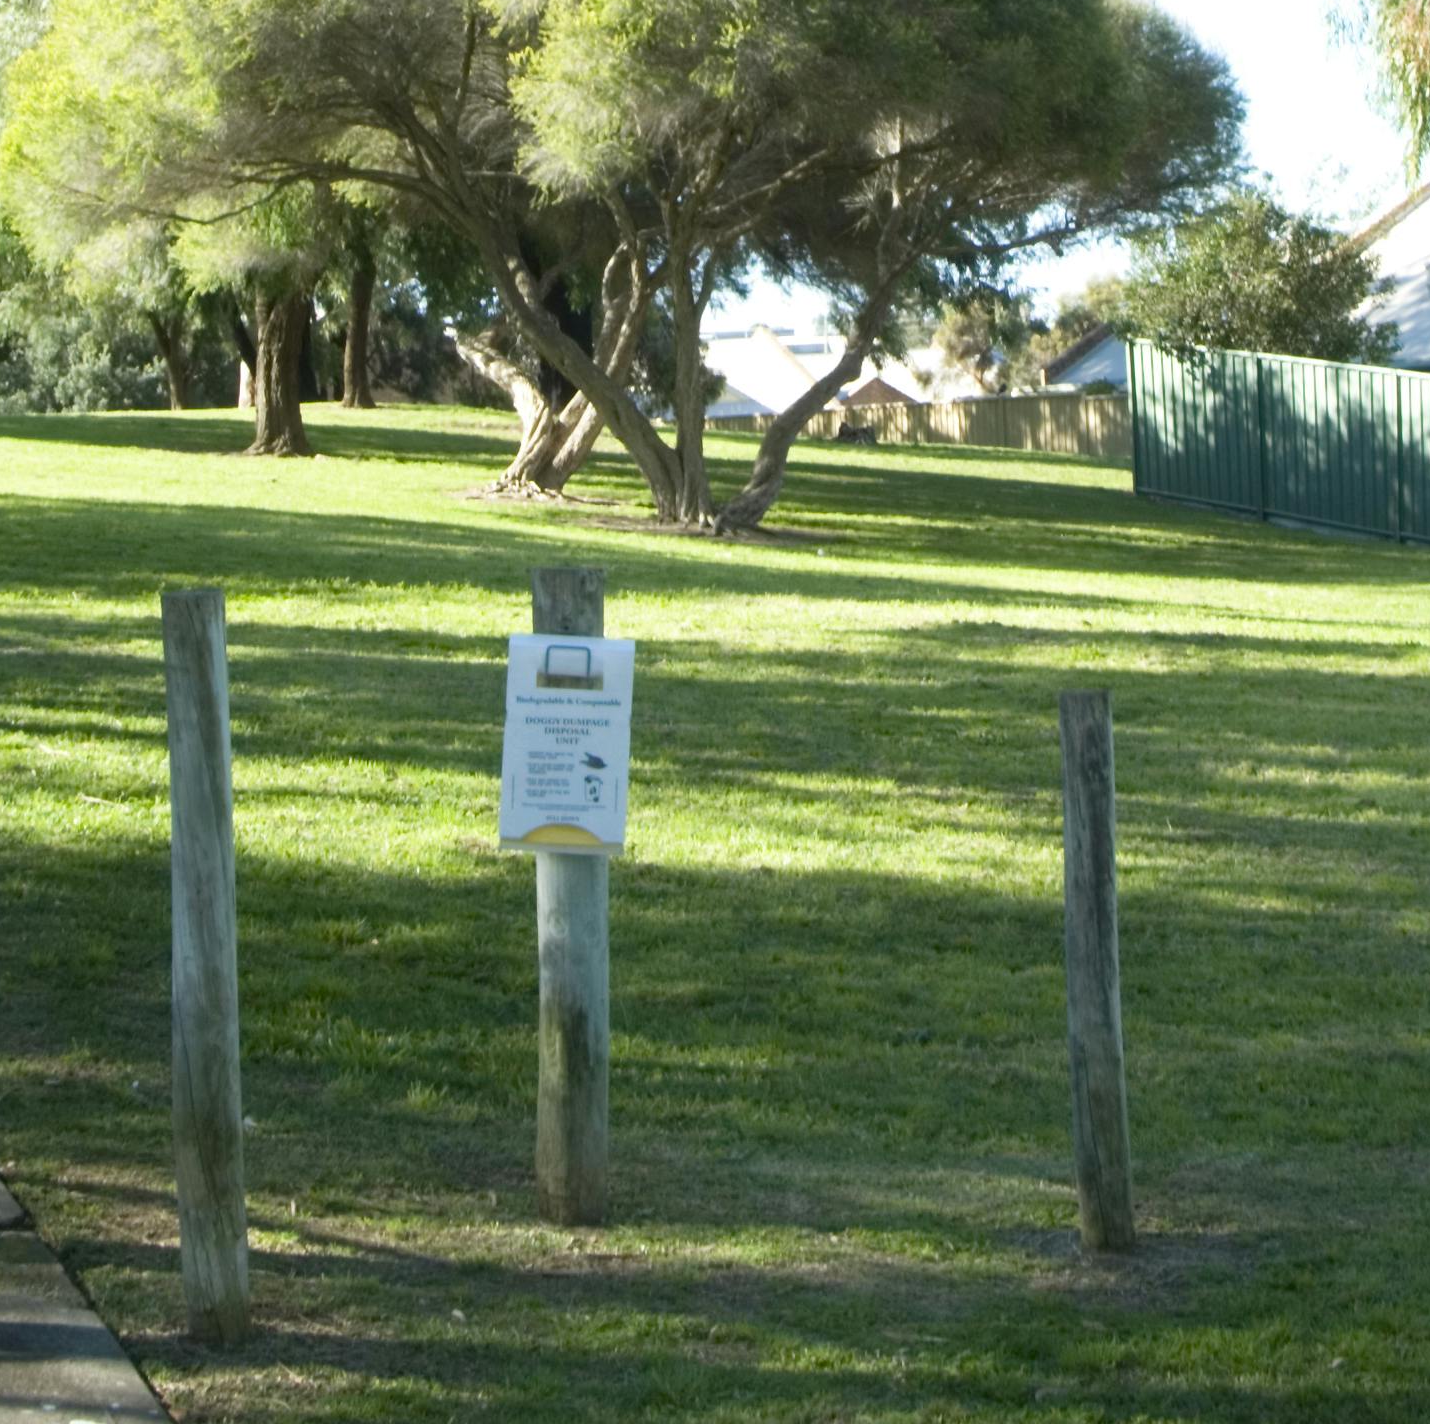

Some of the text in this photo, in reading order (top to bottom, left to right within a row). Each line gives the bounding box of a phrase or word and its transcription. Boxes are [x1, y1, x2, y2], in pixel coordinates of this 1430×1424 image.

[525, 716, 610, 727] DOGGY DUMPAGE
[544, 726, 590, 736] DISPOSAL
[555, 736, 580, 745] UNIT
